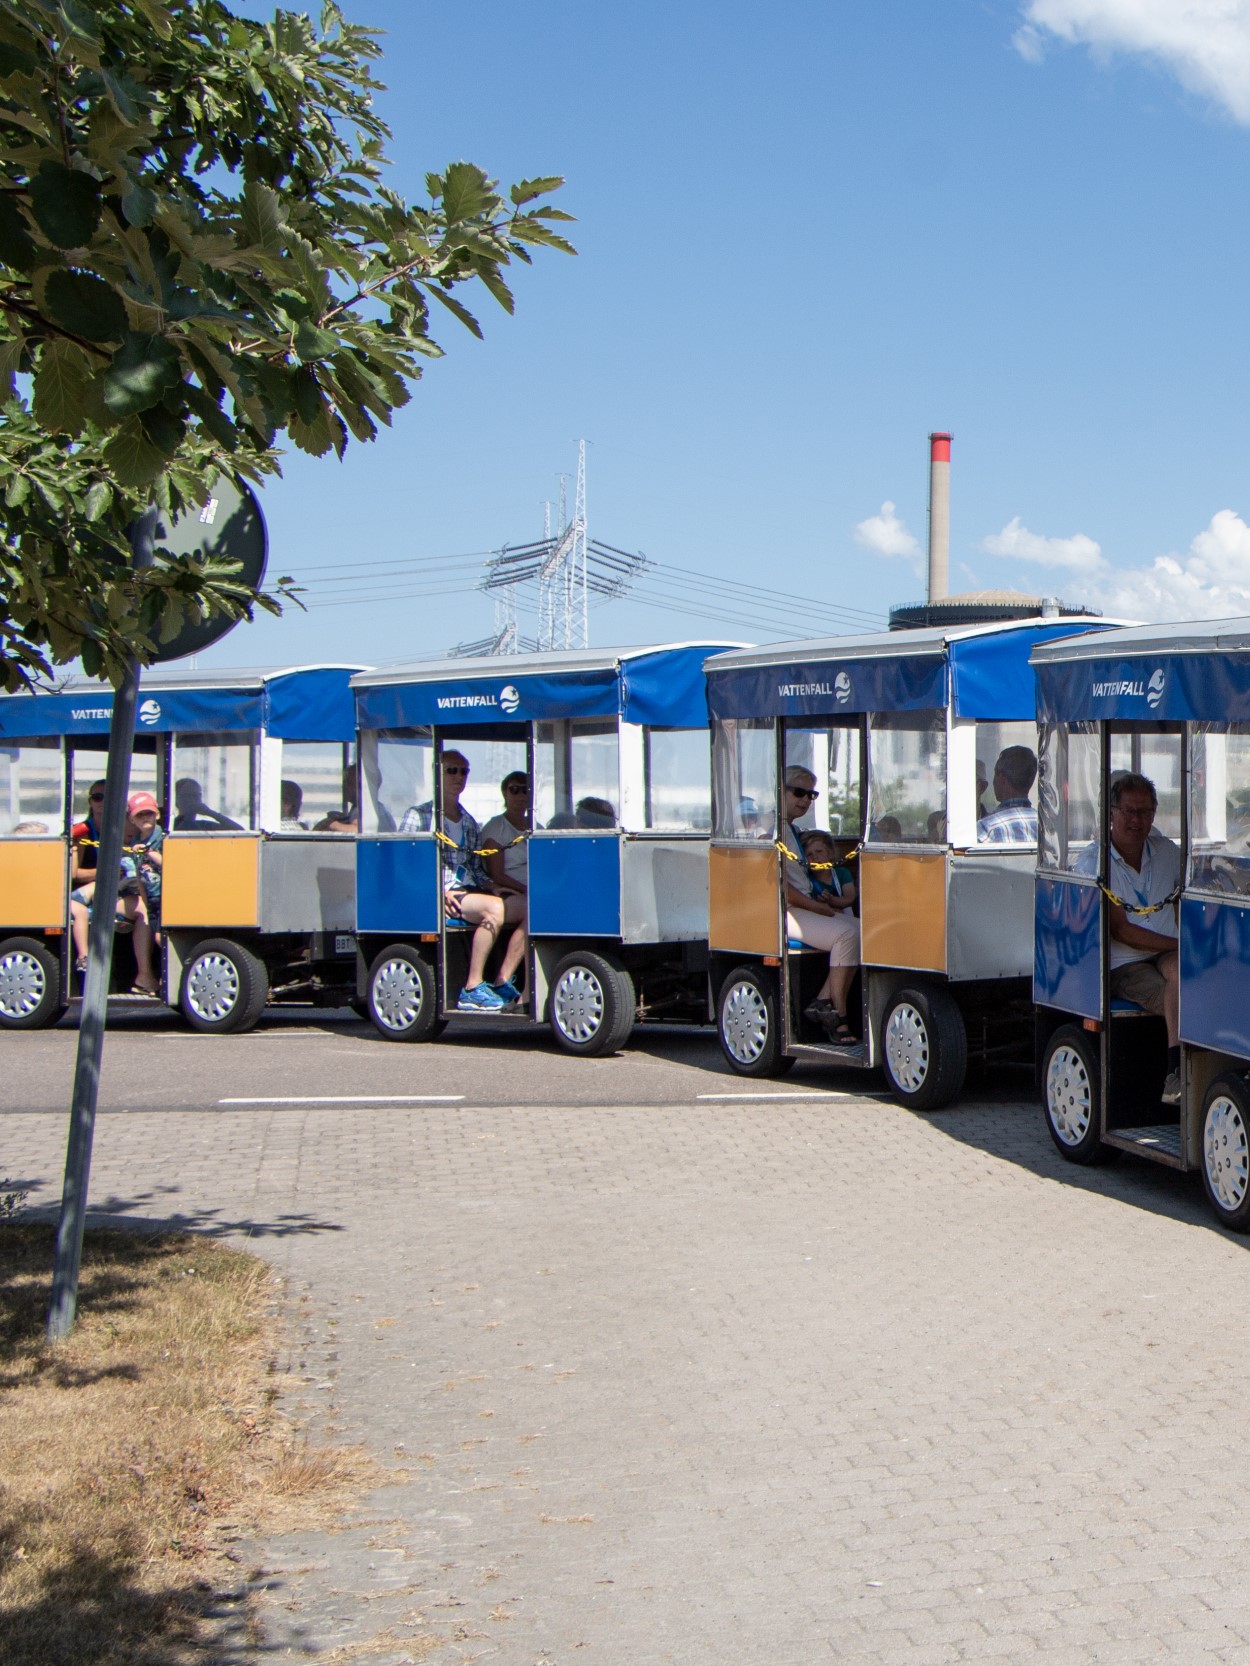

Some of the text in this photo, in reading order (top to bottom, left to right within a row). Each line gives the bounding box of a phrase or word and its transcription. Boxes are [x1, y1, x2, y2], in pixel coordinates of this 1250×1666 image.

[777, 683, 833, 697] VATTENFALL
[1092, 681, 1145, 697] VATTENFALL
[437, 694, 498, 709] VATTENFALL
[71, 708, 114, 720] VATTEN
